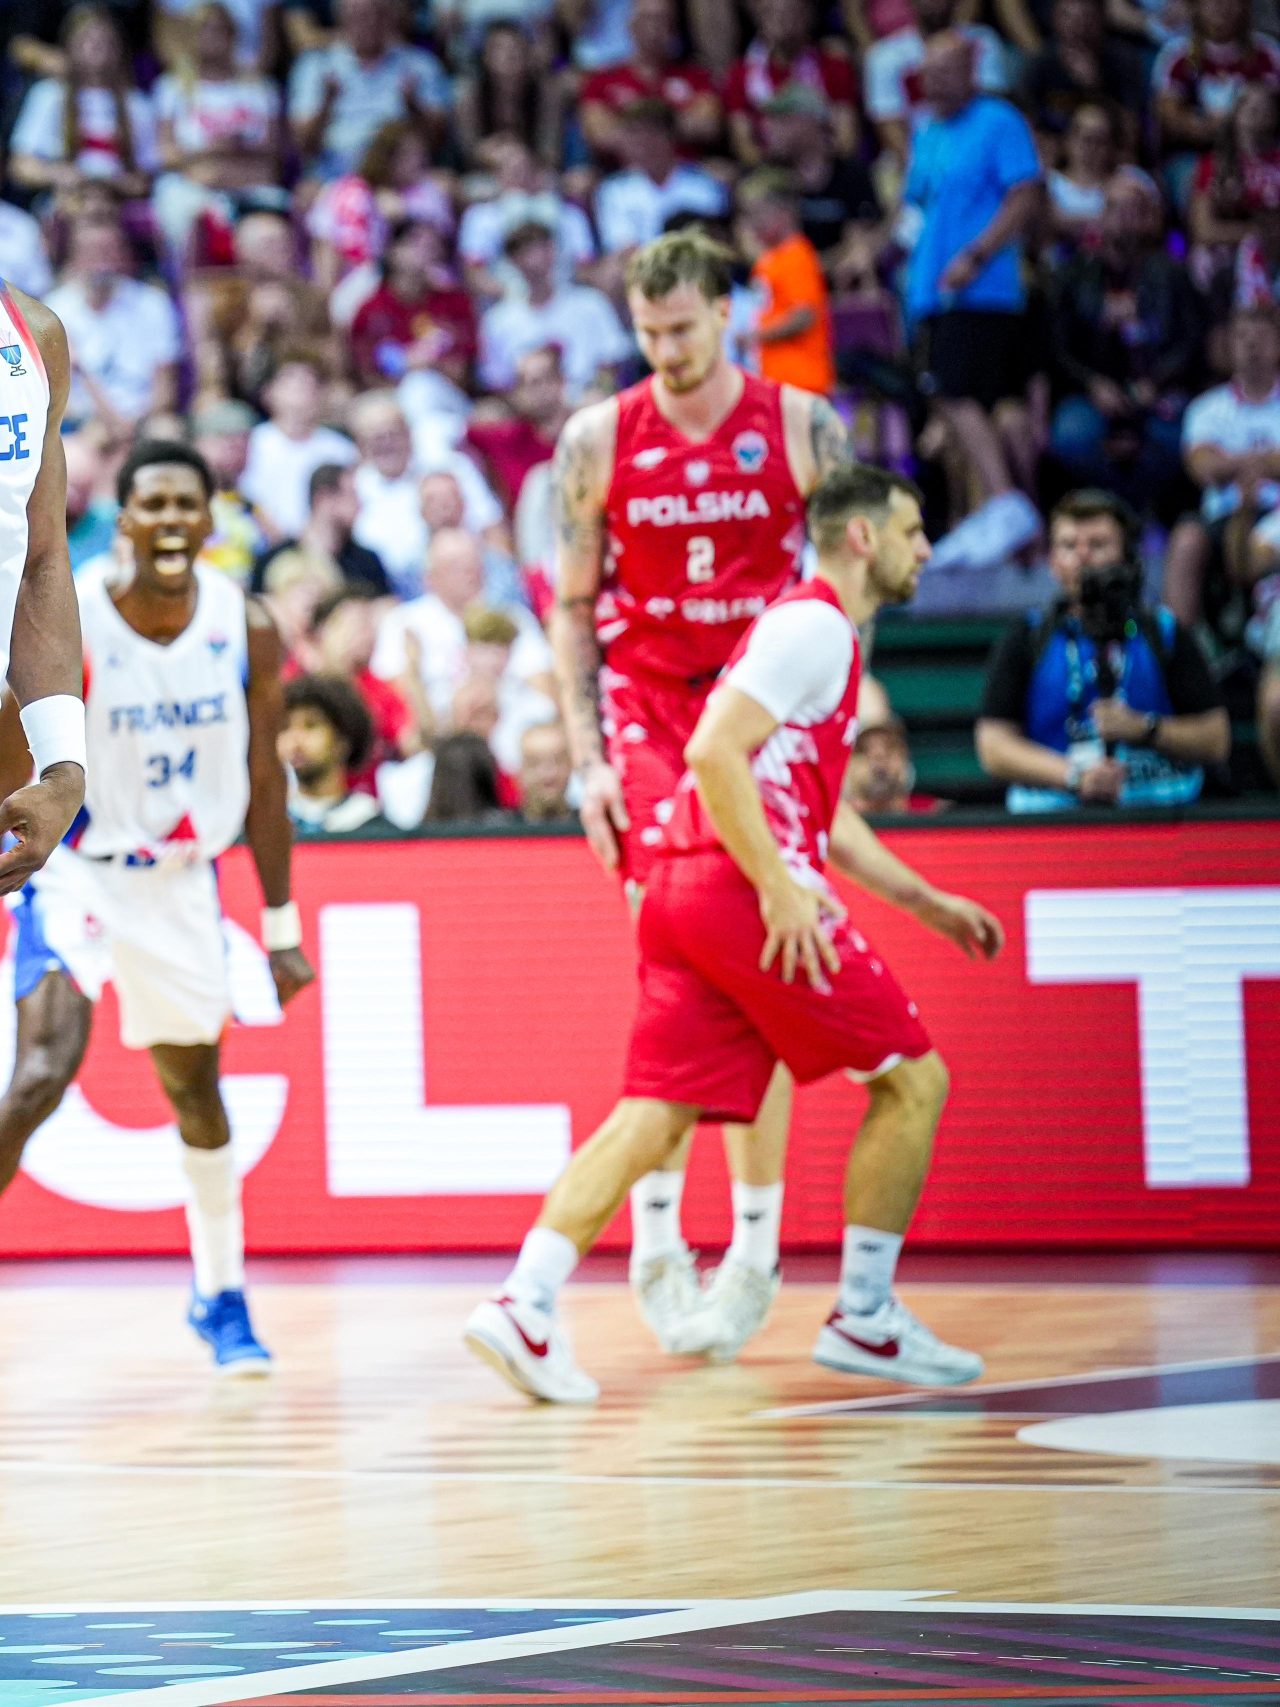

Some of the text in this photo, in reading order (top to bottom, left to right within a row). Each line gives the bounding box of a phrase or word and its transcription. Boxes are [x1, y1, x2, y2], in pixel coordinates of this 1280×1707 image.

[626, 490, 770, 527] POLSKA
[686, 536, 716, 583] 2
[109, 695, 228, 732] FRANCE
[147, 751, 196, 789] 34
